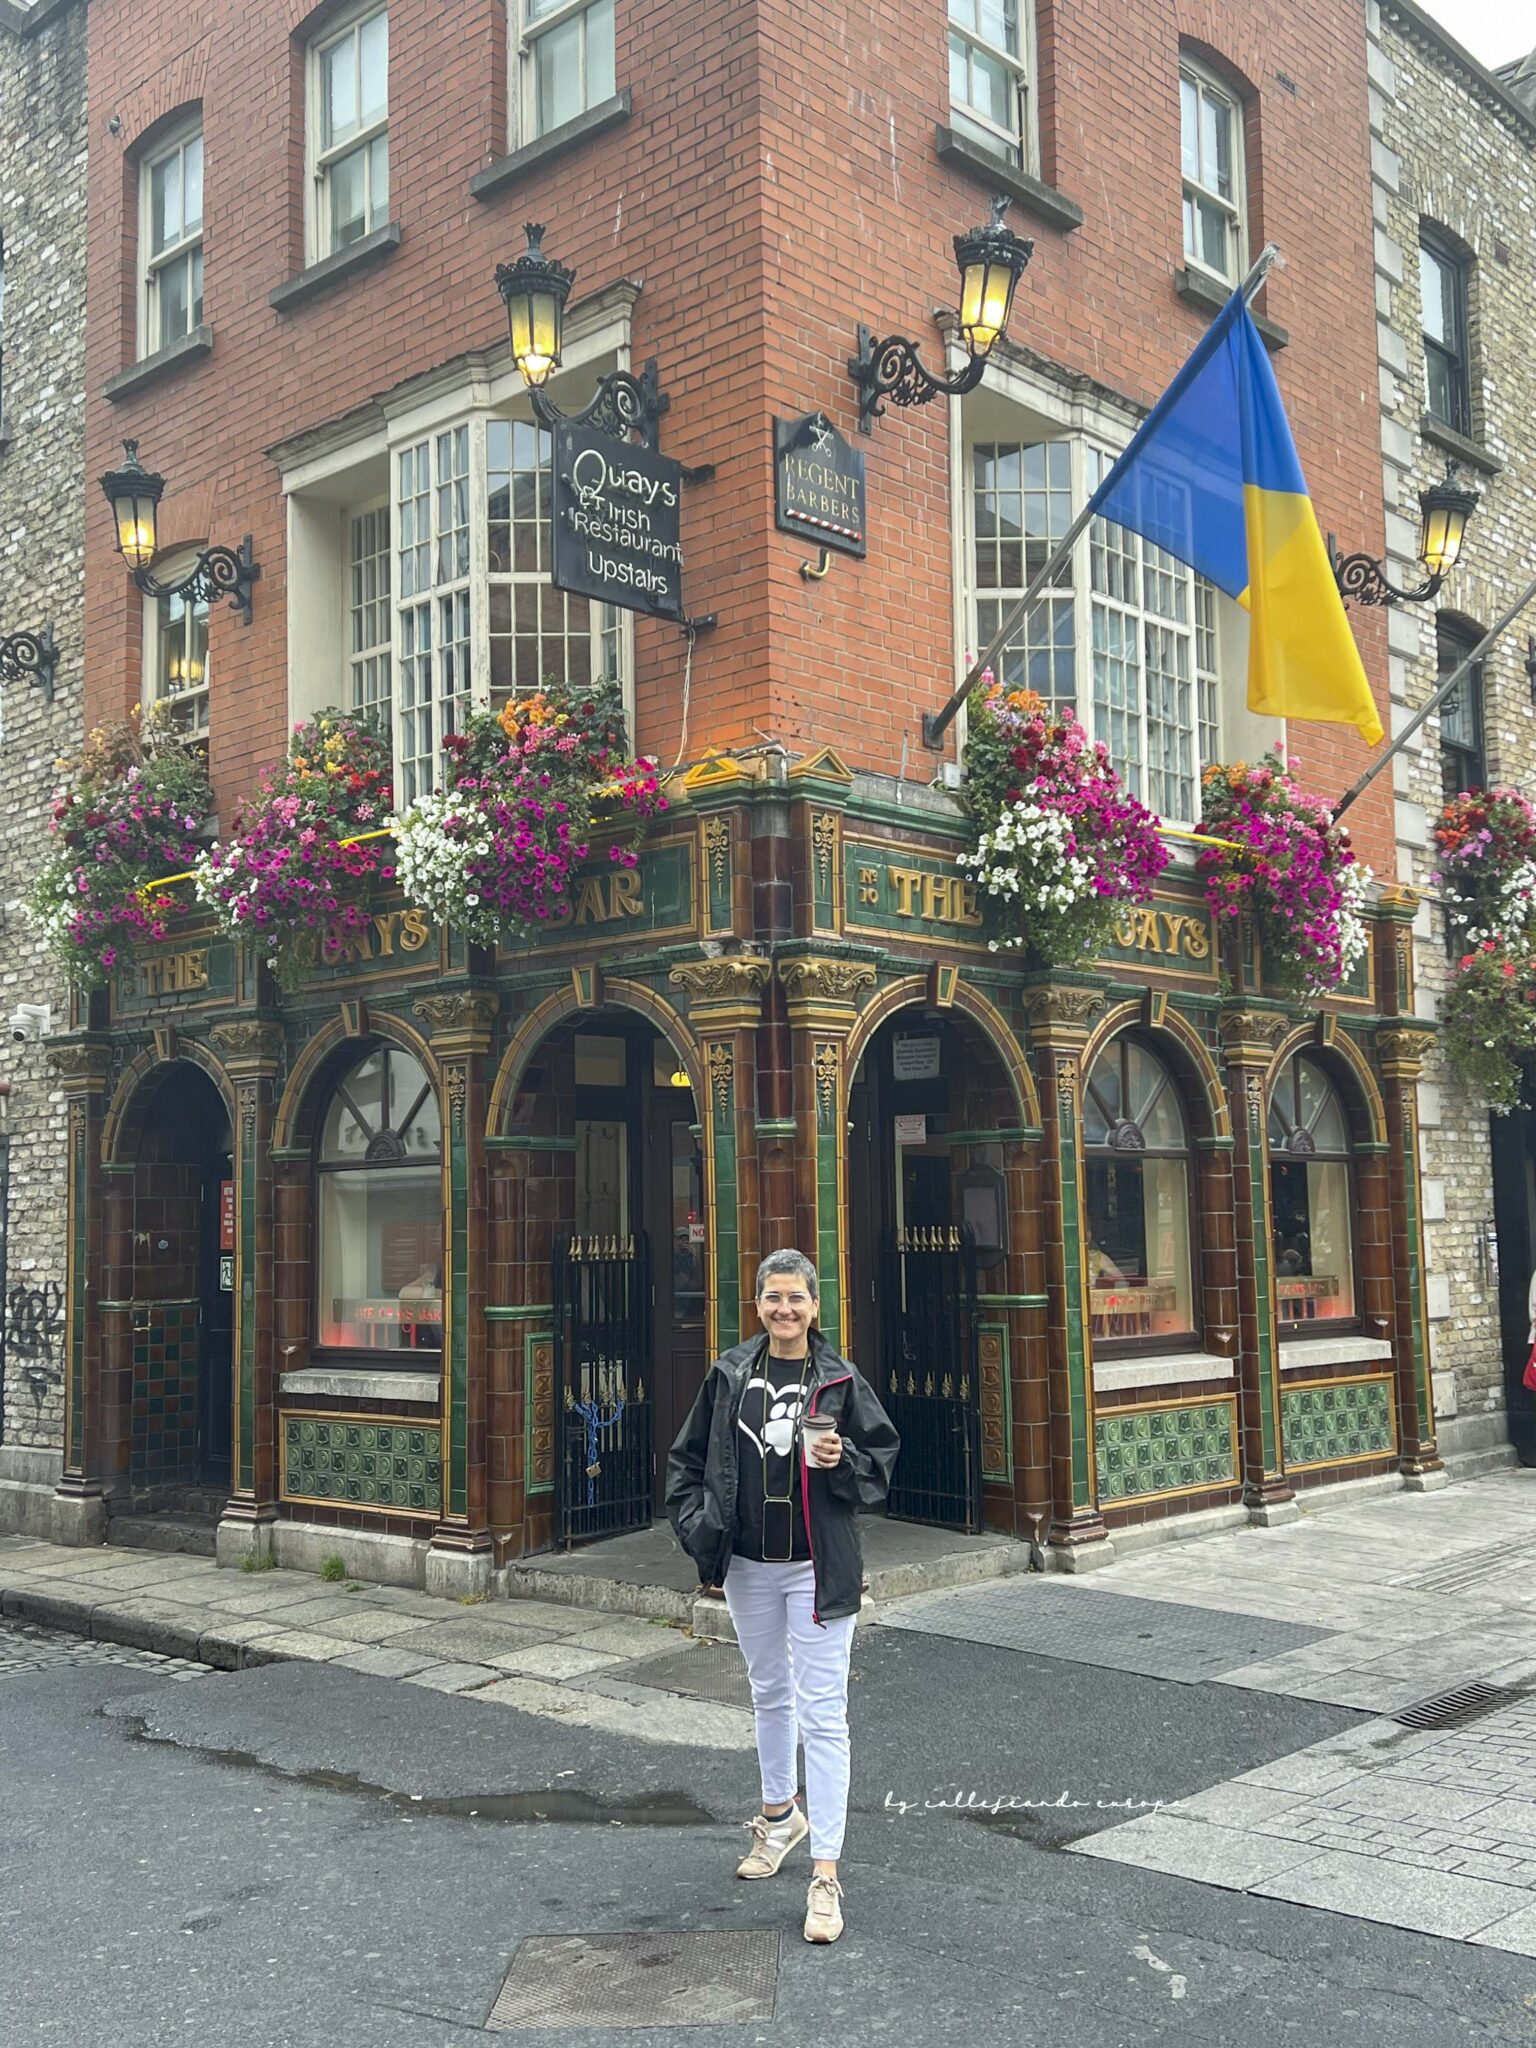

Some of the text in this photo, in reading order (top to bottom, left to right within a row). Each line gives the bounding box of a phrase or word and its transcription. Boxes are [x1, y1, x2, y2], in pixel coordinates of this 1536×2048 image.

[573, 449, 676, 507] Quays
[785, 453, 860, 499] REGENT
[786, 473, 860, 524] BARBERS
[574, 511, 683, 562] Restaurant
[608, 502, 651, 532] Irish
[588, 550, 669, 595] Upstairs
[888, 865, 1210, 959] THE UAYS
[141, 948, 209, 996] THE
[293, 908, 430, 968] UAYS
